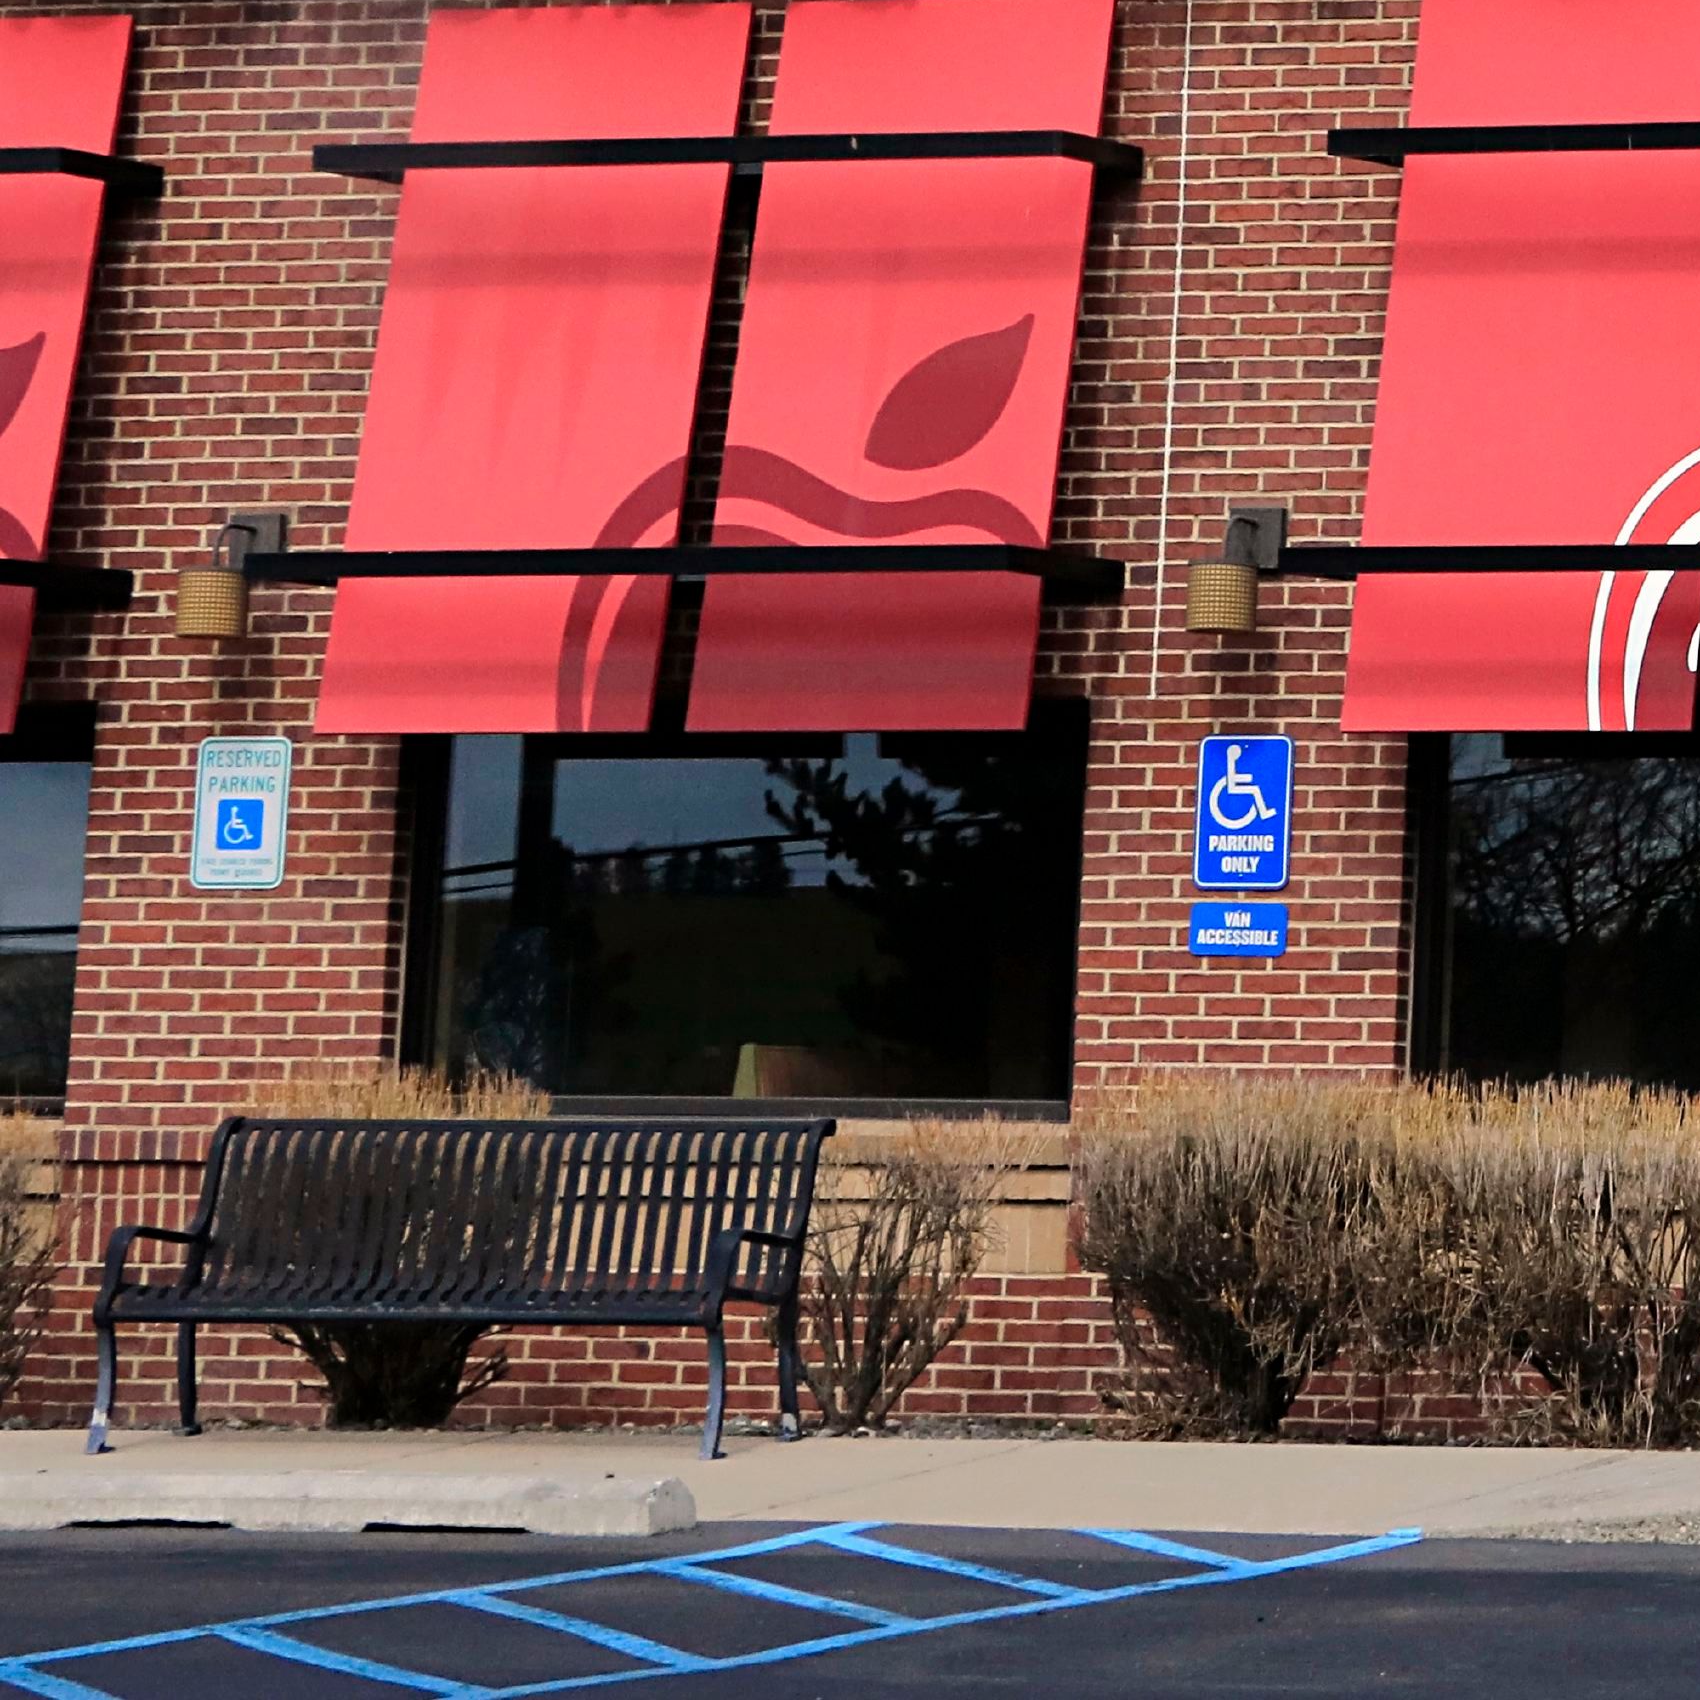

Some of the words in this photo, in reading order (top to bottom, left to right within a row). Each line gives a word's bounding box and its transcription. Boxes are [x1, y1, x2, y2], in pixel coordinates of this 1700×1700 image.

[206, 749, 282, 768] RESERVED
[208, 775, 276, 793] PARKING
[1208, 835, 1274, 853] PARKING
[1221, 856, 1260, 874] ONLY
[1224, 911, 1251, 927] VAN
[1196, 929, 1279, 945] ACCESSIBLE
